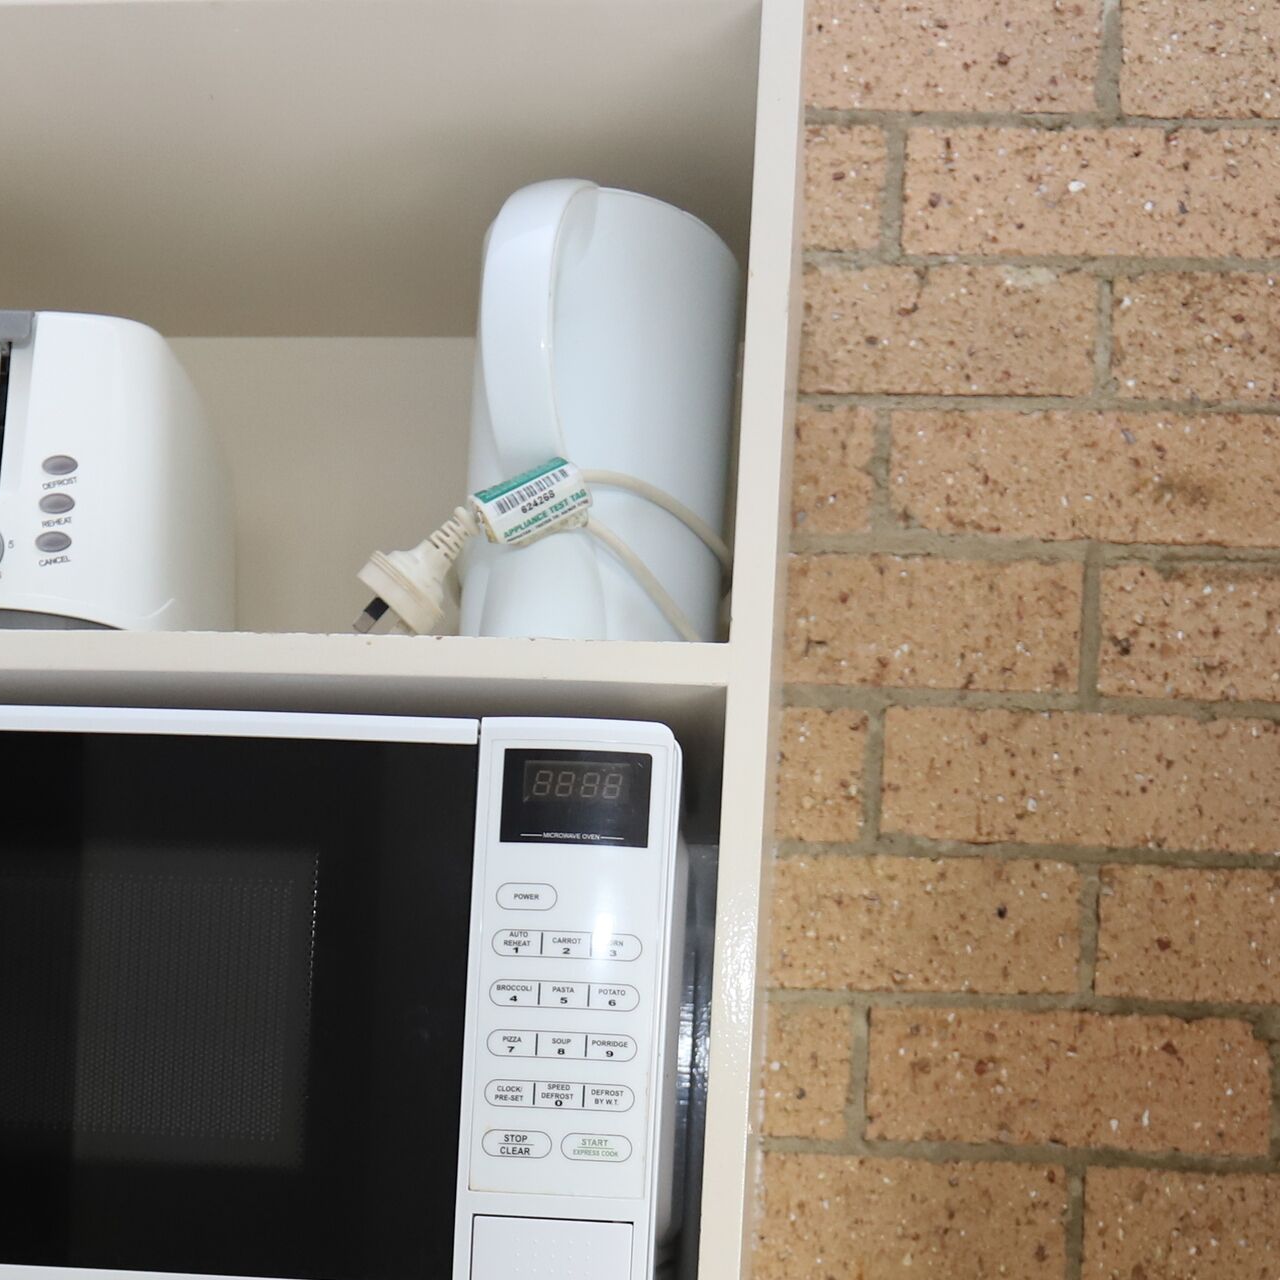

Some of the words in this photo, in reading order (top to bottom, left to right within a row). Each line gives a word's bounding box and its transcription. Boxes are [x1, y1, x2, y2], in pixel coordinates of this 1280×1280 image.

[42, 477, 77, 490] DEFROST
[504, 510, 549, 538] APPLIANCE
[550, 499, 570, 515] TEST
[570, 489, 588, 505] TAG
[42, 516, 72, 528] REHEAT
[7, 540, 15, 549] 5
[38, 555, 72, 567] CANCEL
[542, 832, 581, 840] MICROWAVE
[582, 833, 601, 841] OVEN
[513, 893, 540, 901] POWER
[562, 947, 570, 955] 2
[609, 949, 618, 957] 3
[496, 984, 532, 992] BROCCOLI
[598, 988, 626, 996] POTATO
[608, 999, 616, 1007] 6
[552, 1037, 571, 1045] SOUP
[591, 1040, 628, 1048] PORRIDGE
[605, 1050, 614, 1058] 9
[591, 1089, 624, 1097] DEFROST
[504, 1134, 528, 1143] STOP
[581, 1138, 608, 1147] START
[499, 1146, 530, 1155] CLEAR
